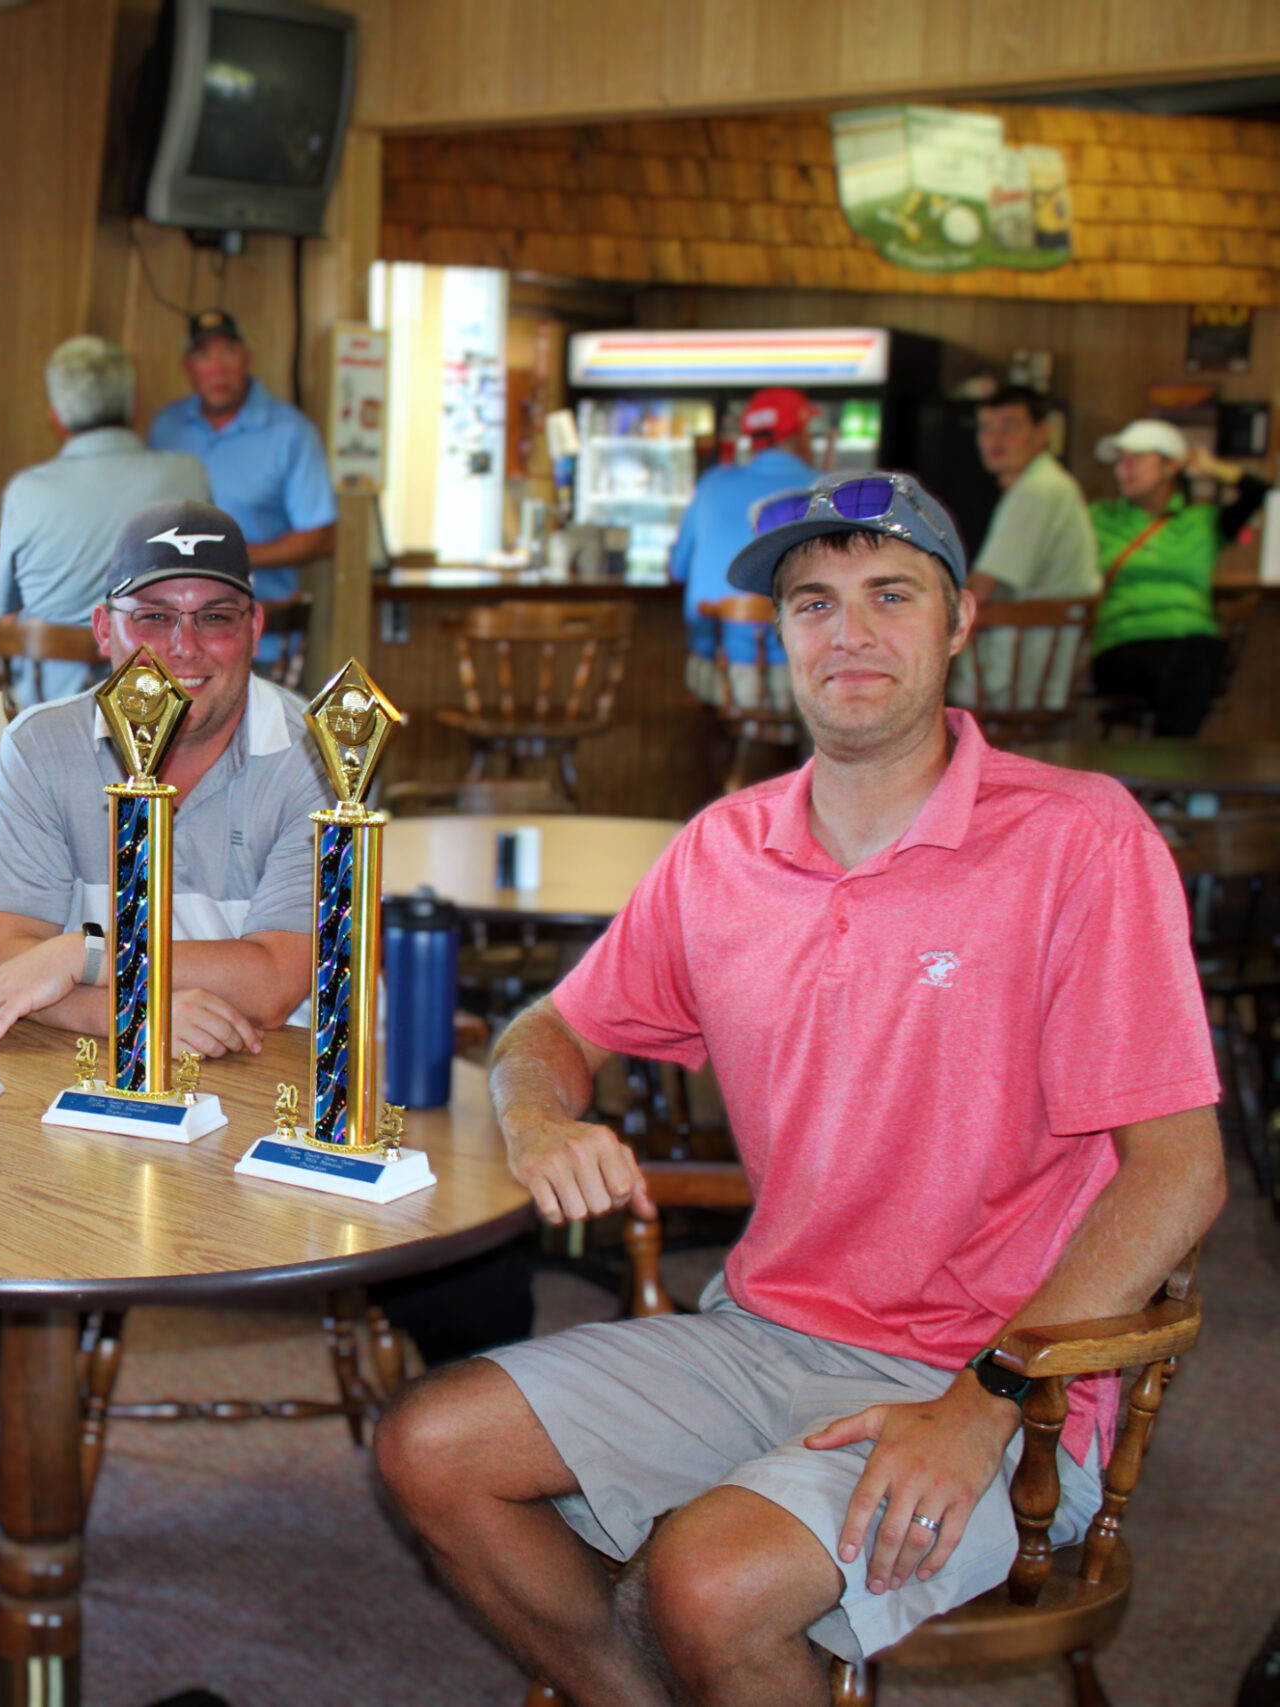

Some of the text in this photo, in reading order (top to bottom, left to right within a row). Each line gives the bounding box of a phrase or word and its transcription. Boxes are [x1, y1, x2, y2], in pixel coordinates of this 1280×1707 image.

[75, 1037, 201, 1078] 20 25
[275, 1082, 299, 1108] 20
